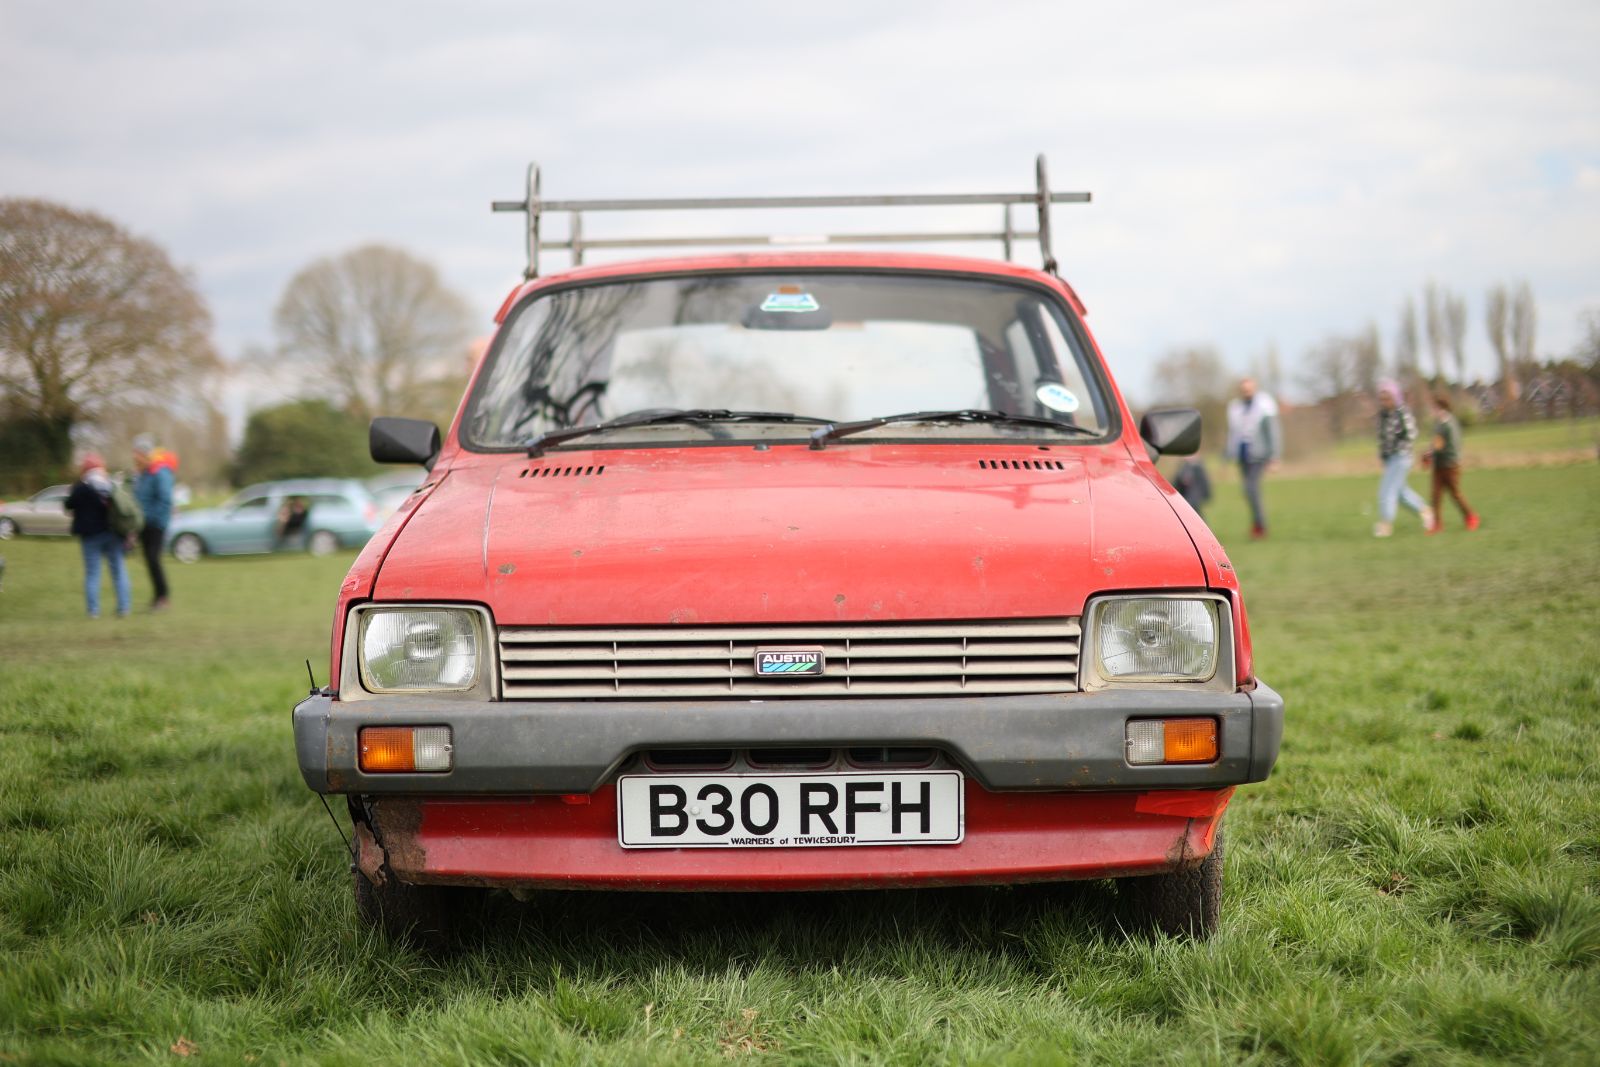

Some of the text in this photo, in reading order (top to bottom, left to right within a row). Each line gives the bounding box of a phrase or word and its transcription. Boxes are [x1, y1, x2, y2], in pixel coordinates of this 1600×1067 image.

[763, 654, 817, 663] AUSTIN
[649, 781, 931, 837] B30 RFH
[731, 837, 774, 845] WARNERS
[794, 836, 856, 845] TEWKESBURY
